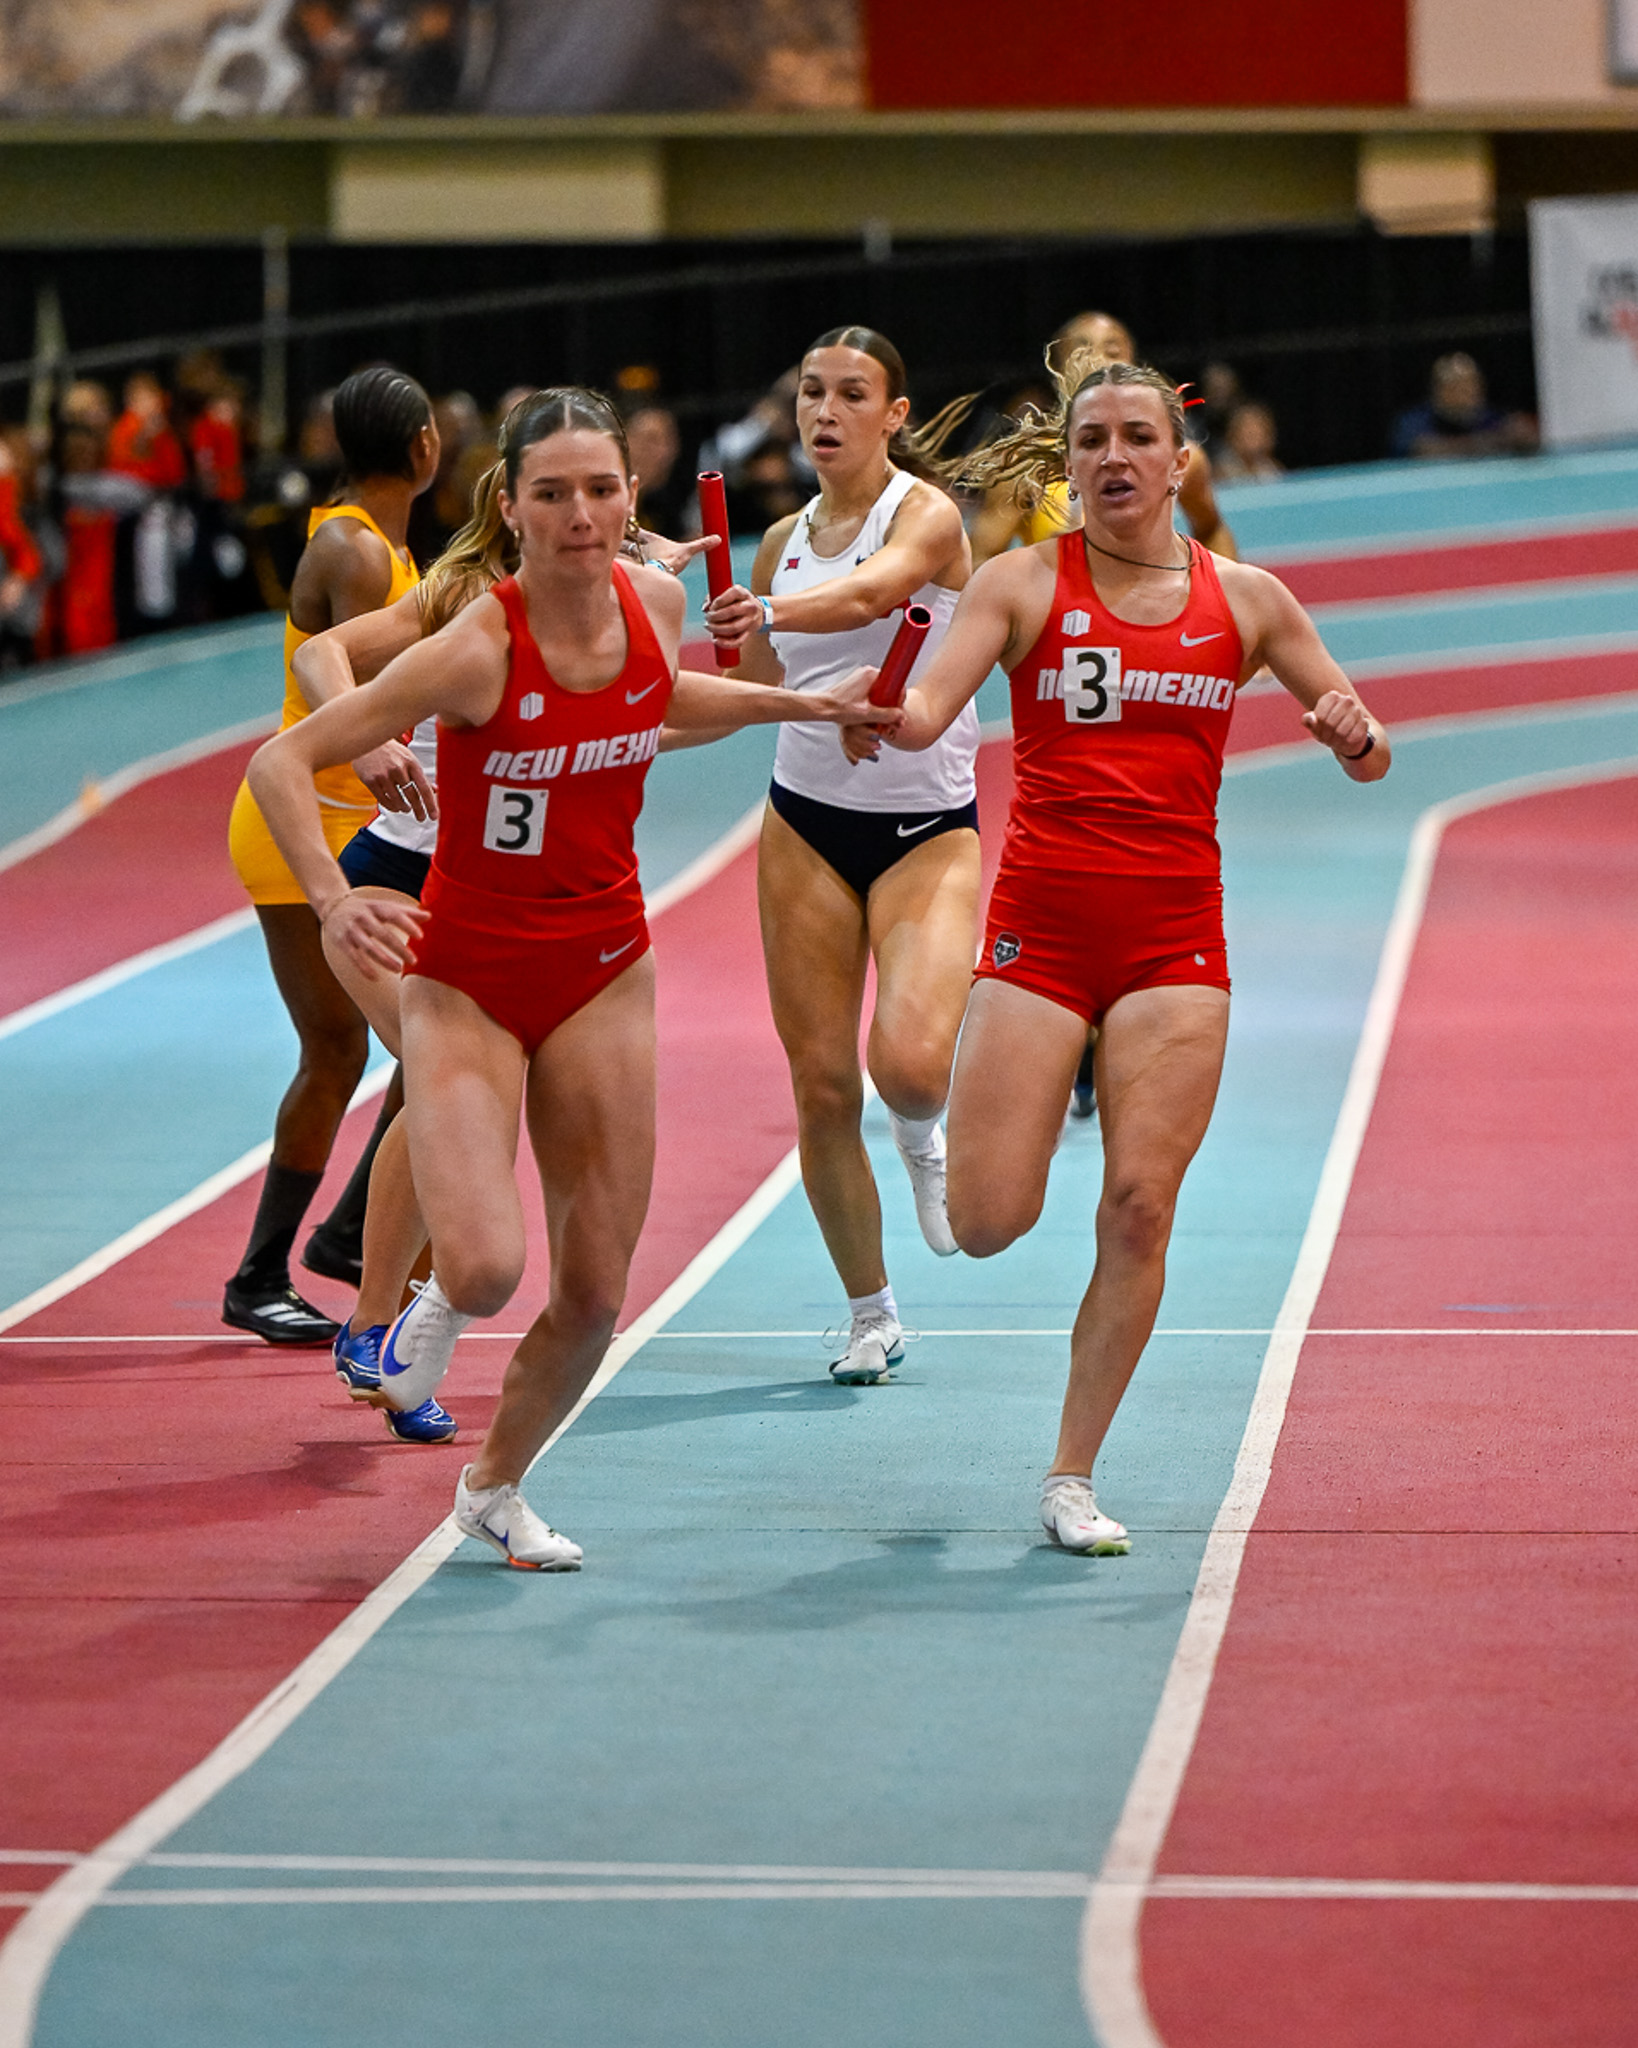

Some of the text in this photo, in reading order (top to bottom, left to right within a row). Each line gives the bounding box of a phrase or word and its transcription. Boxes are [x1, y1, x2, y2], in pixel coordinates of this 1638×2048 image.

[1076, 651, 1107, 719] 3
[1121, 669, 1235, 711] MEXICO
[483, 745, 568, 781] NEW
[495, 792, 533, 850] 3
